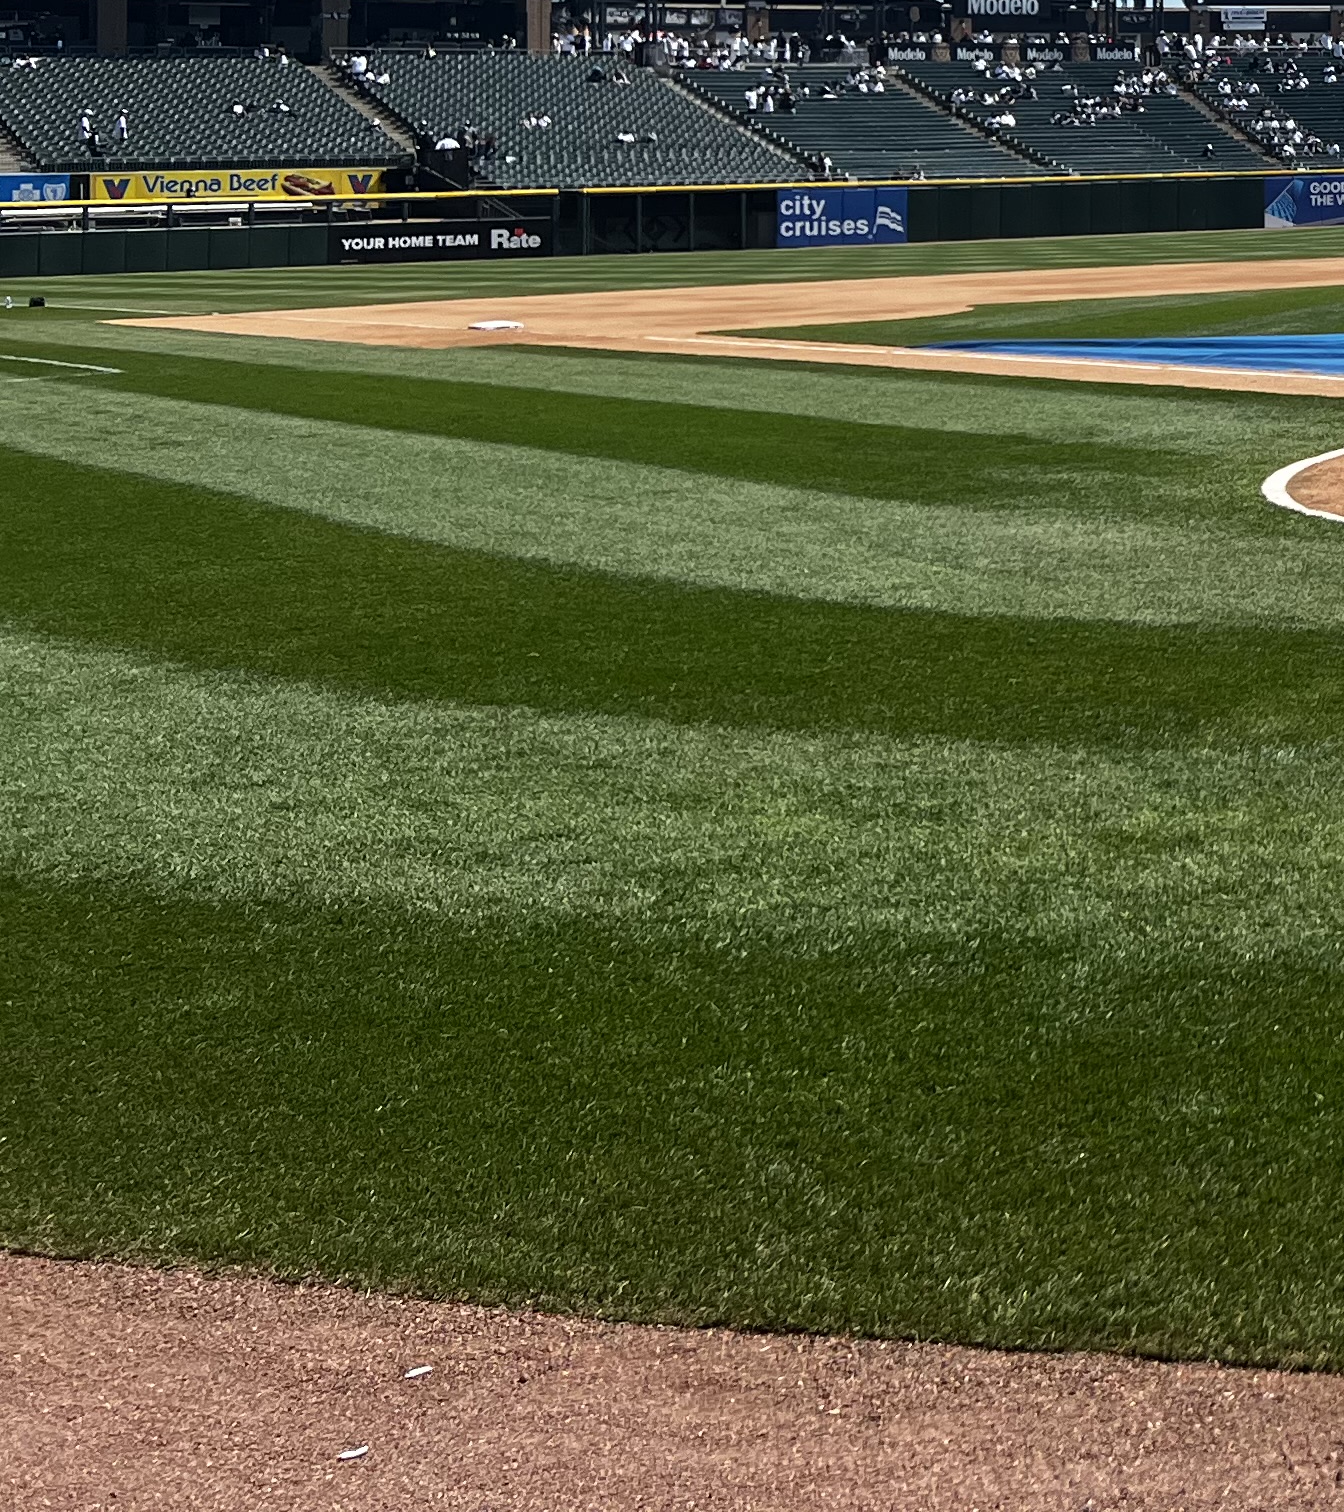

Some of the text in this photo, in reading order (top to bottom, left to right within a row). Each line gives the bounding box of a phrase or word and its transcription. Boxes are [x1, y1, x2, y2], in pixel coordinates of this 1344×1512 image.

[142, 173, 279, 194] Vienna Beef
[780, 195, 826, 220] city
[1310, 194, 1334, 206] THE
[780, 216, 869, 238] cruises
[342, 228, 541, 250] YOUR HOME TEAM Rate
